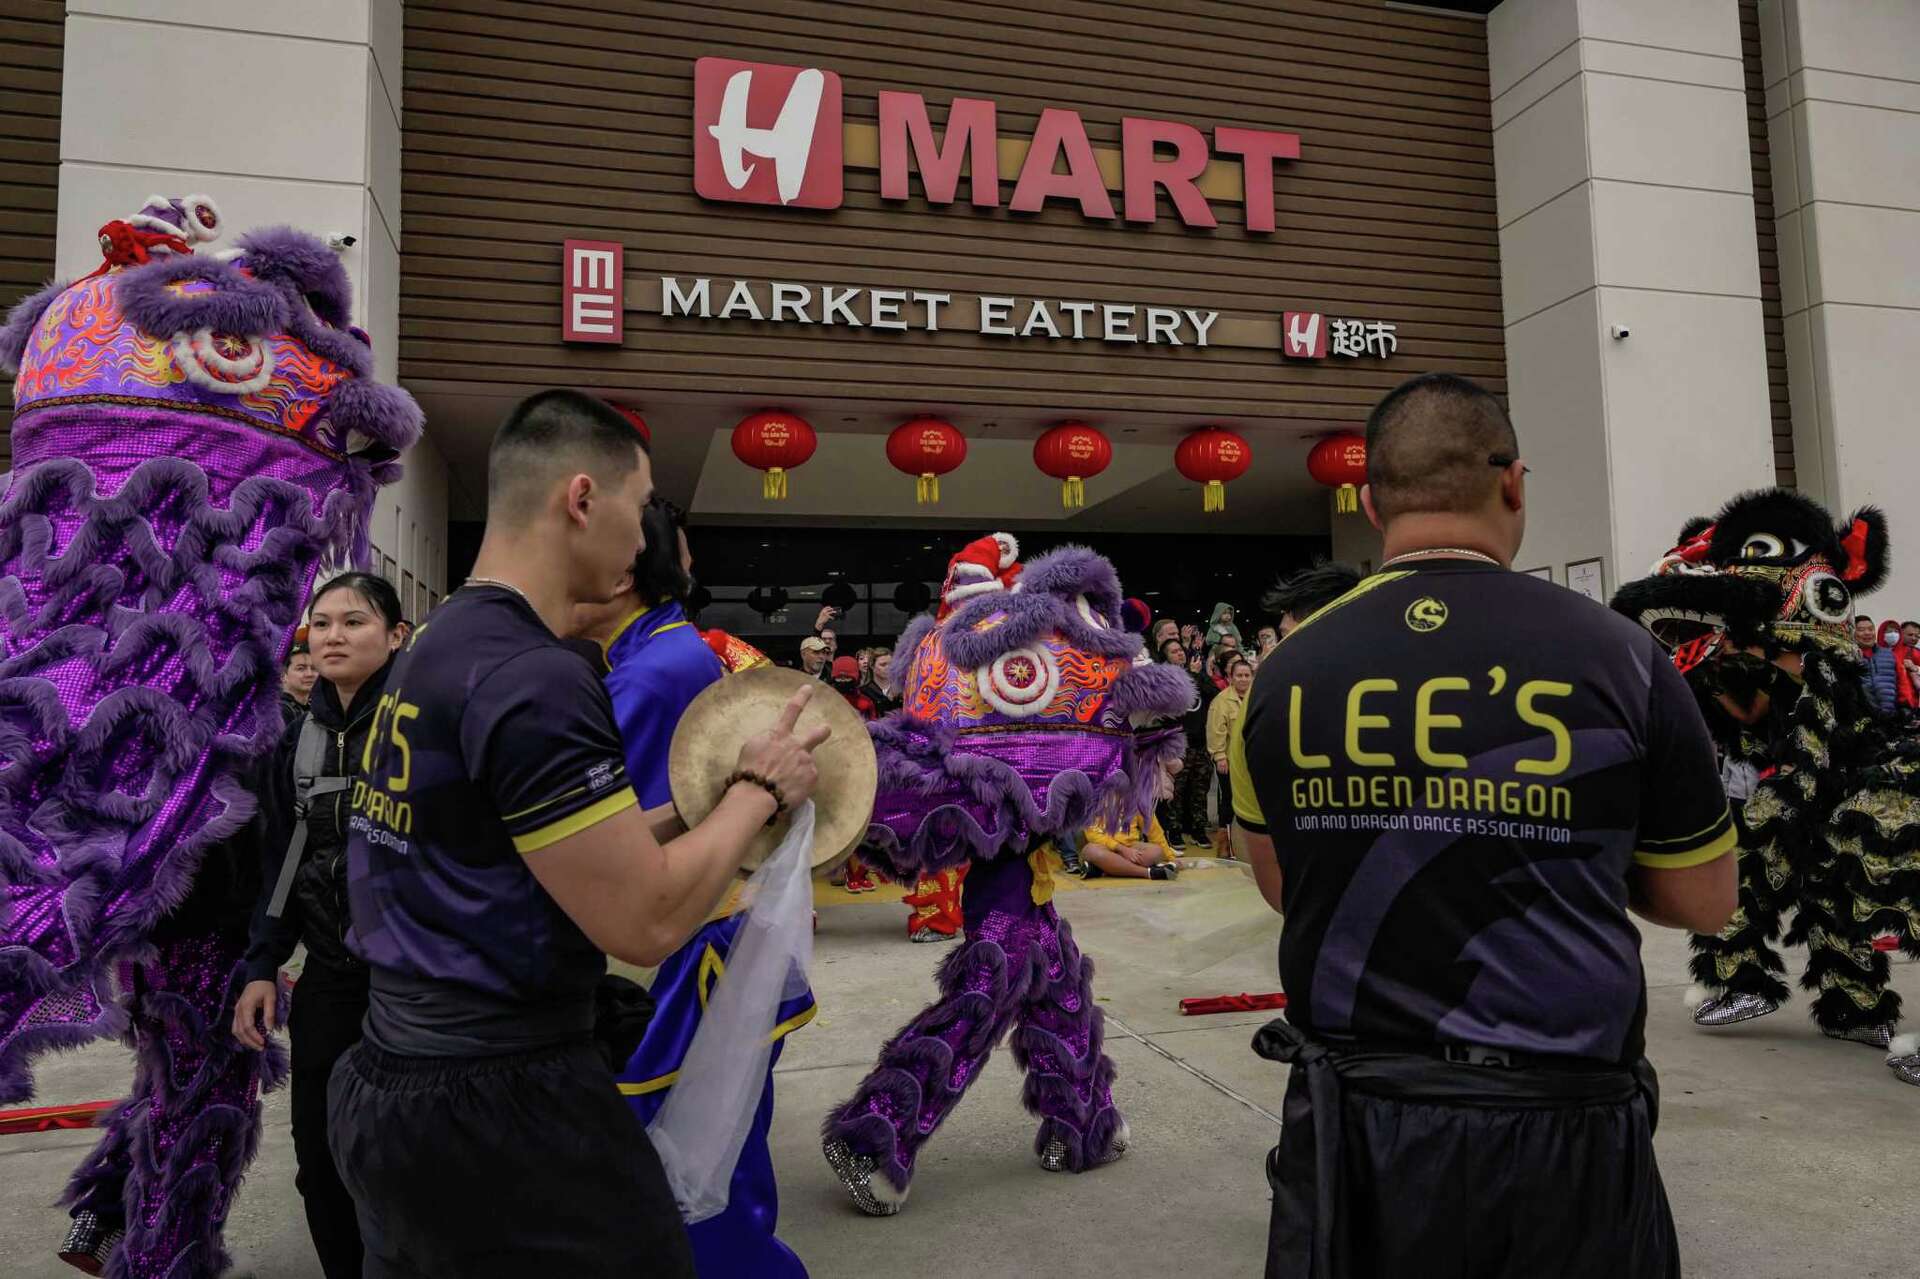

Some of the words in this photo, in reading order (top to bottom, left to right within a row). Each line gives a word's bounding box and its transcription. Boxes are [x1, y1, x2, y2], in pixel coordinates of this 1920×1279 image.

[708, 68, 825, 205] H
[878, 90, 1300, 233] MART
[661, 276, 950, 331] MARKET
[979, 296, 1219, 346] EATERY
[1287, 313, 1320, 357] H
[1332, 319, 1397, 359] 超市
[1288, 666, 1573, 776] LEE'S
[1292, 776, 1413, 808] GOLDEN
[1425, 776, 1571, 821] DRAGON
[1295, 815, 1319, 831] LION
[1321, 814, 1347, 830] AND
[1351, 814, 1409, 830] DRAGON
[1413, 815, 1463, 833] DANCE
[1467, 818, 1571, 844] ASSOCIATION
